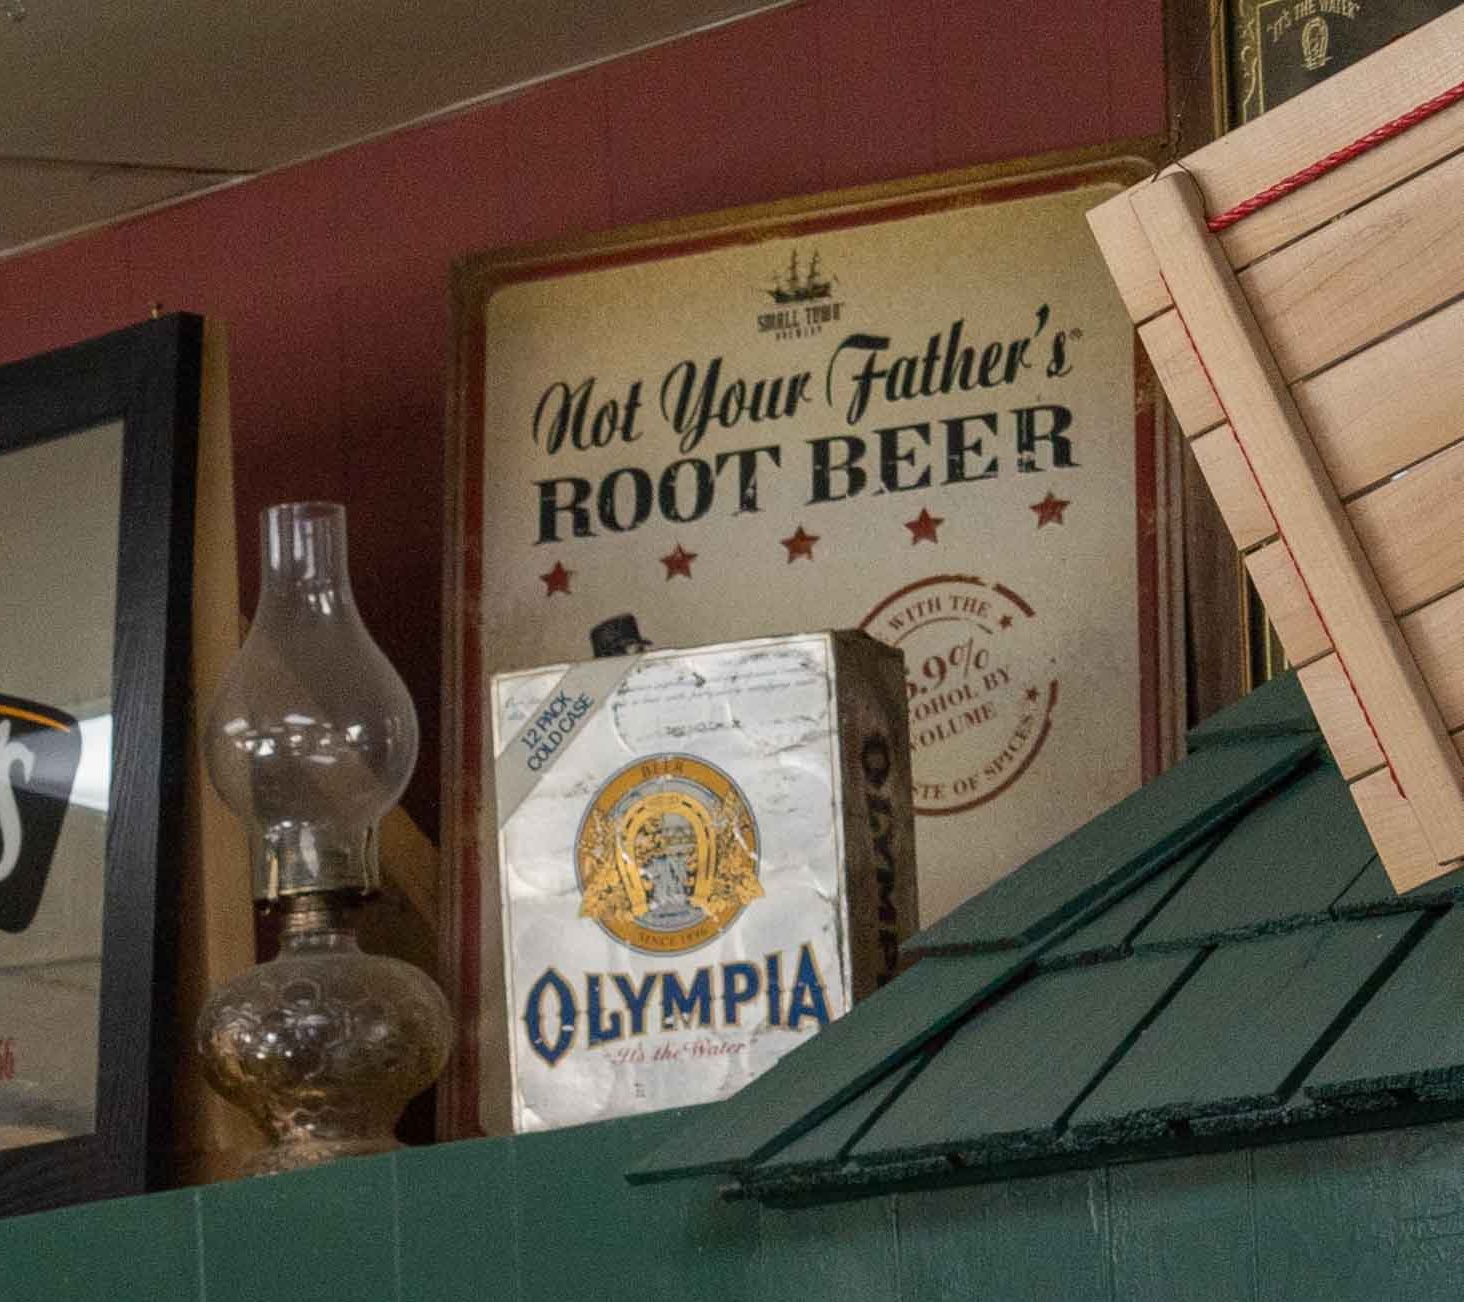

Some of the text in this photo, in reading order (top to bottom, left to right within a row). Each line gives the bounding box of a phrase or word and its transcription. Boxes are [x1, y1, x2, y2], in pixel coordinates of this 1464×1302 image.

[1296, 8, 1319, 29] THE
[532, 303, 1076, 455] Not Your Father's
[534, 403, 1081, 544] ROOT BEER
[888, 596, 992, 630] WITH THE
[982, 667, 1012, 692] BY
[520, 690, 572, 750] 12 PACK
[524, 945, 834, 1067] OLYMPIA
